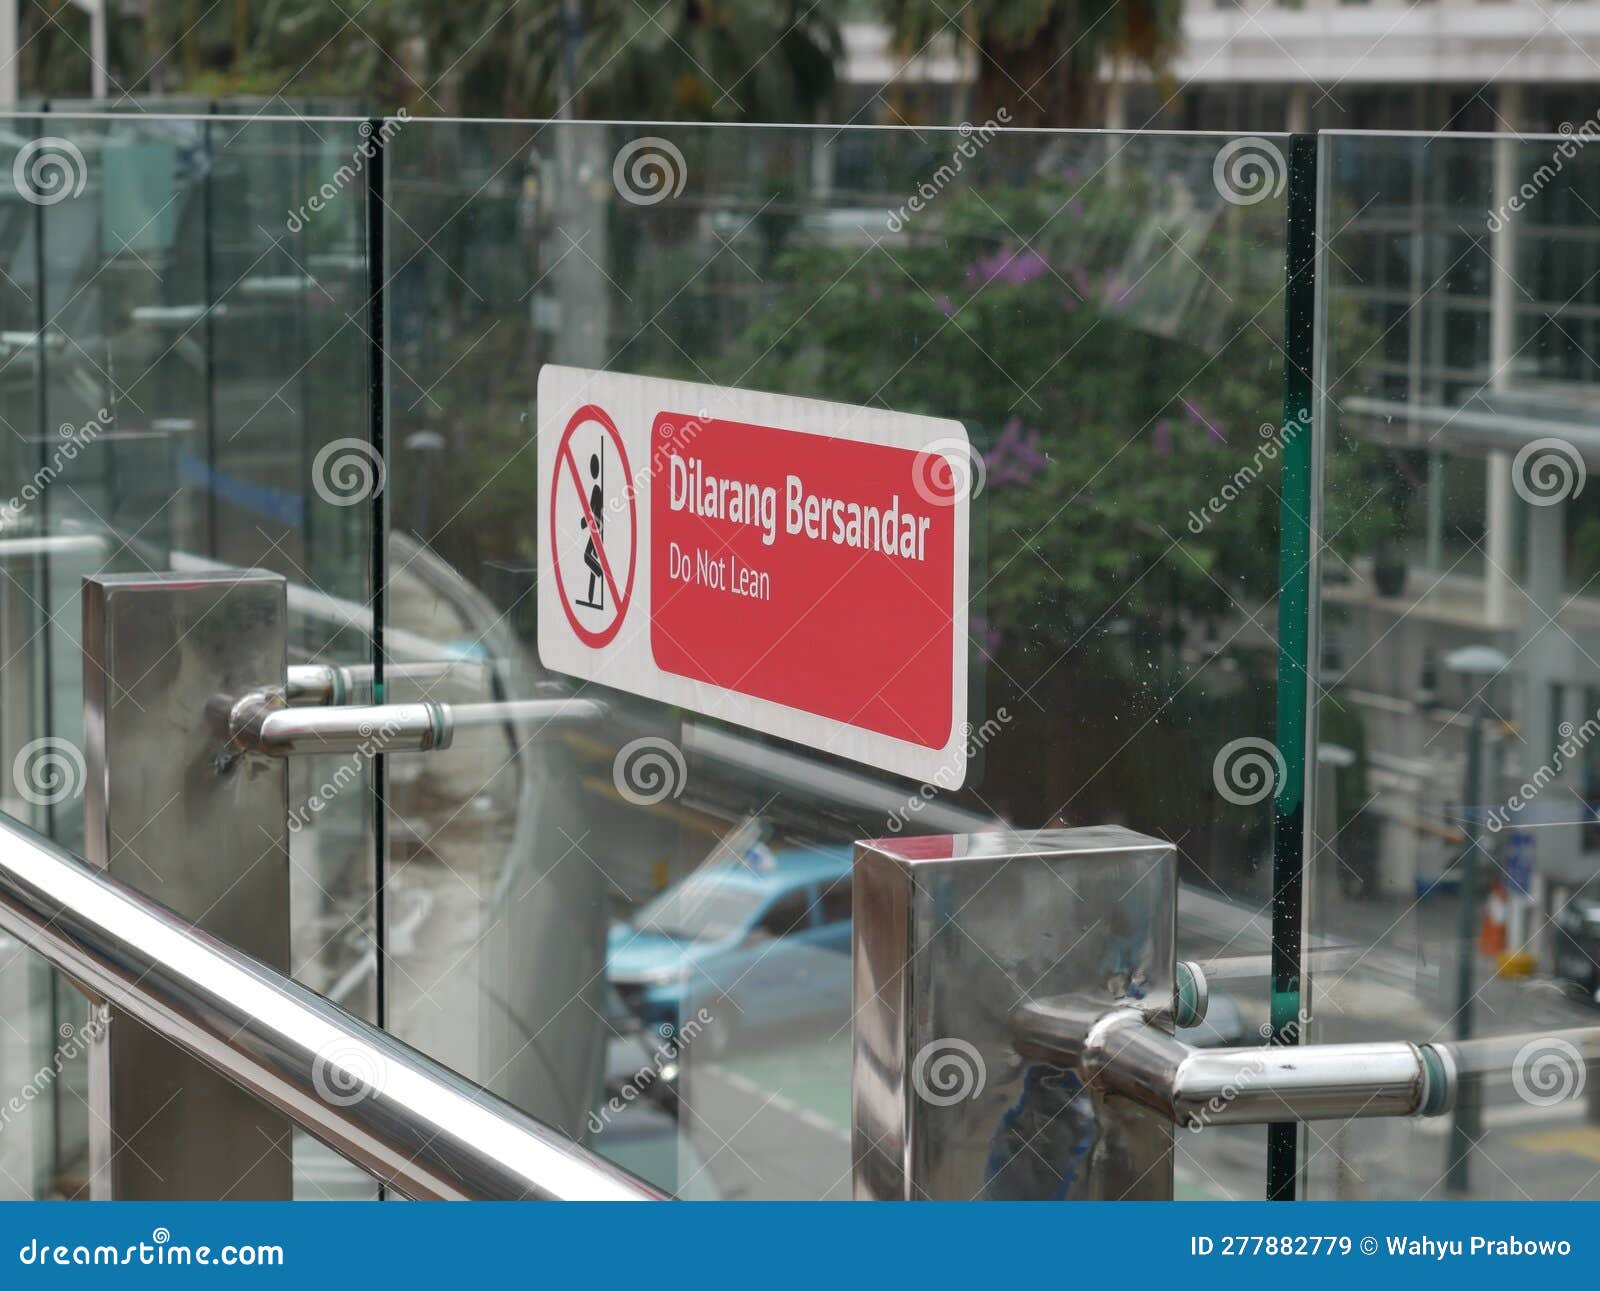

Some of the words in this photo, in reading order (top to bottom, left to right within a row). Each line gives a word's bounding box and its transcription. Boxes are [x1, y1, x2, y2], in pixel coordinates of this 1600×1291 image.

[670, 454, 777, 546] Dilarang
[786, 475, 930, 561] Bersandar
[670, 542, 691, 582] Do
[697, 548, 726, 591] Not
[731, 555, 770, 600] Lean
